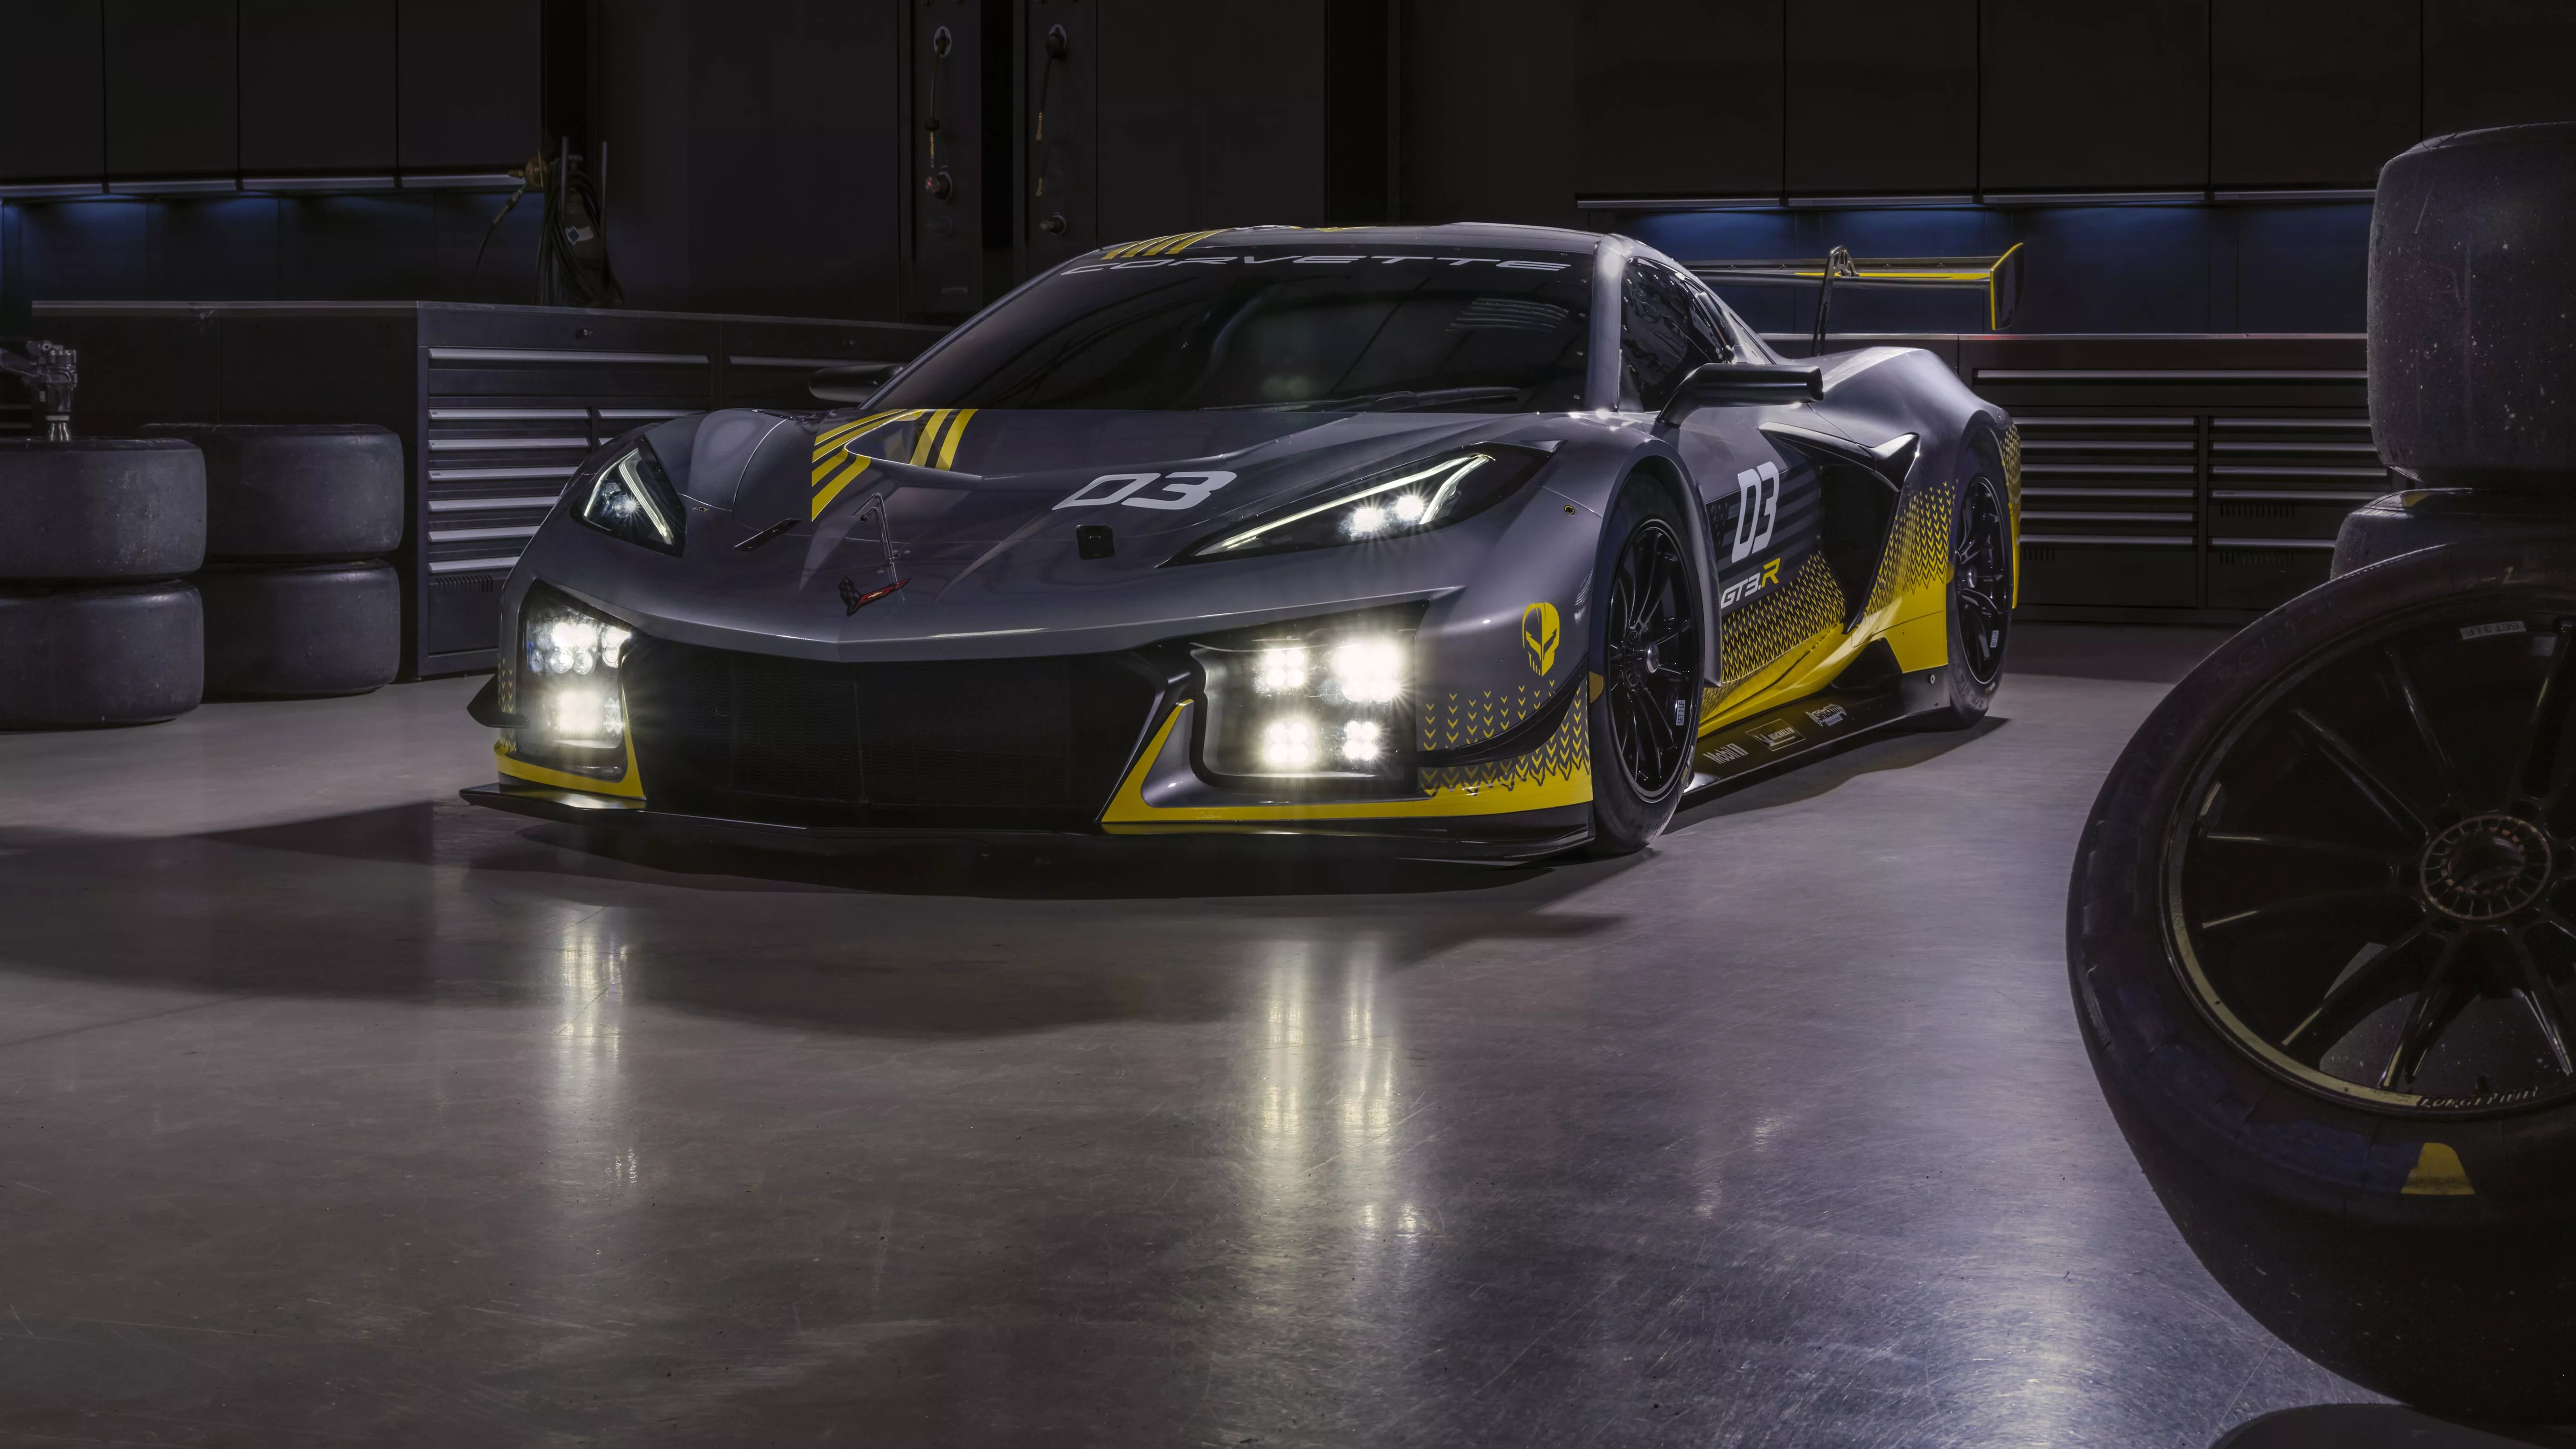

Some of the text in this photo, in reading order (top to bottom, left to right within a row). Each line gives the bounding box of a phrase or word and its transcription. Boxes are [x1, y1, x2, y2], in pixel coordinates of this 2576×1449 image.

[1061, 255, 1571, 276] CORVETTE
[1052, 471, 1237, 510] 03
[1731, 461, 1780, 564] 03
[1720, 557, 1781, 609] GT3.R
[2467, 622, 2520, 637] SET 3 LF
[1767, 726, 1796, 741] MICHELIN
[1702, 746, 1741, 764] Mobil
